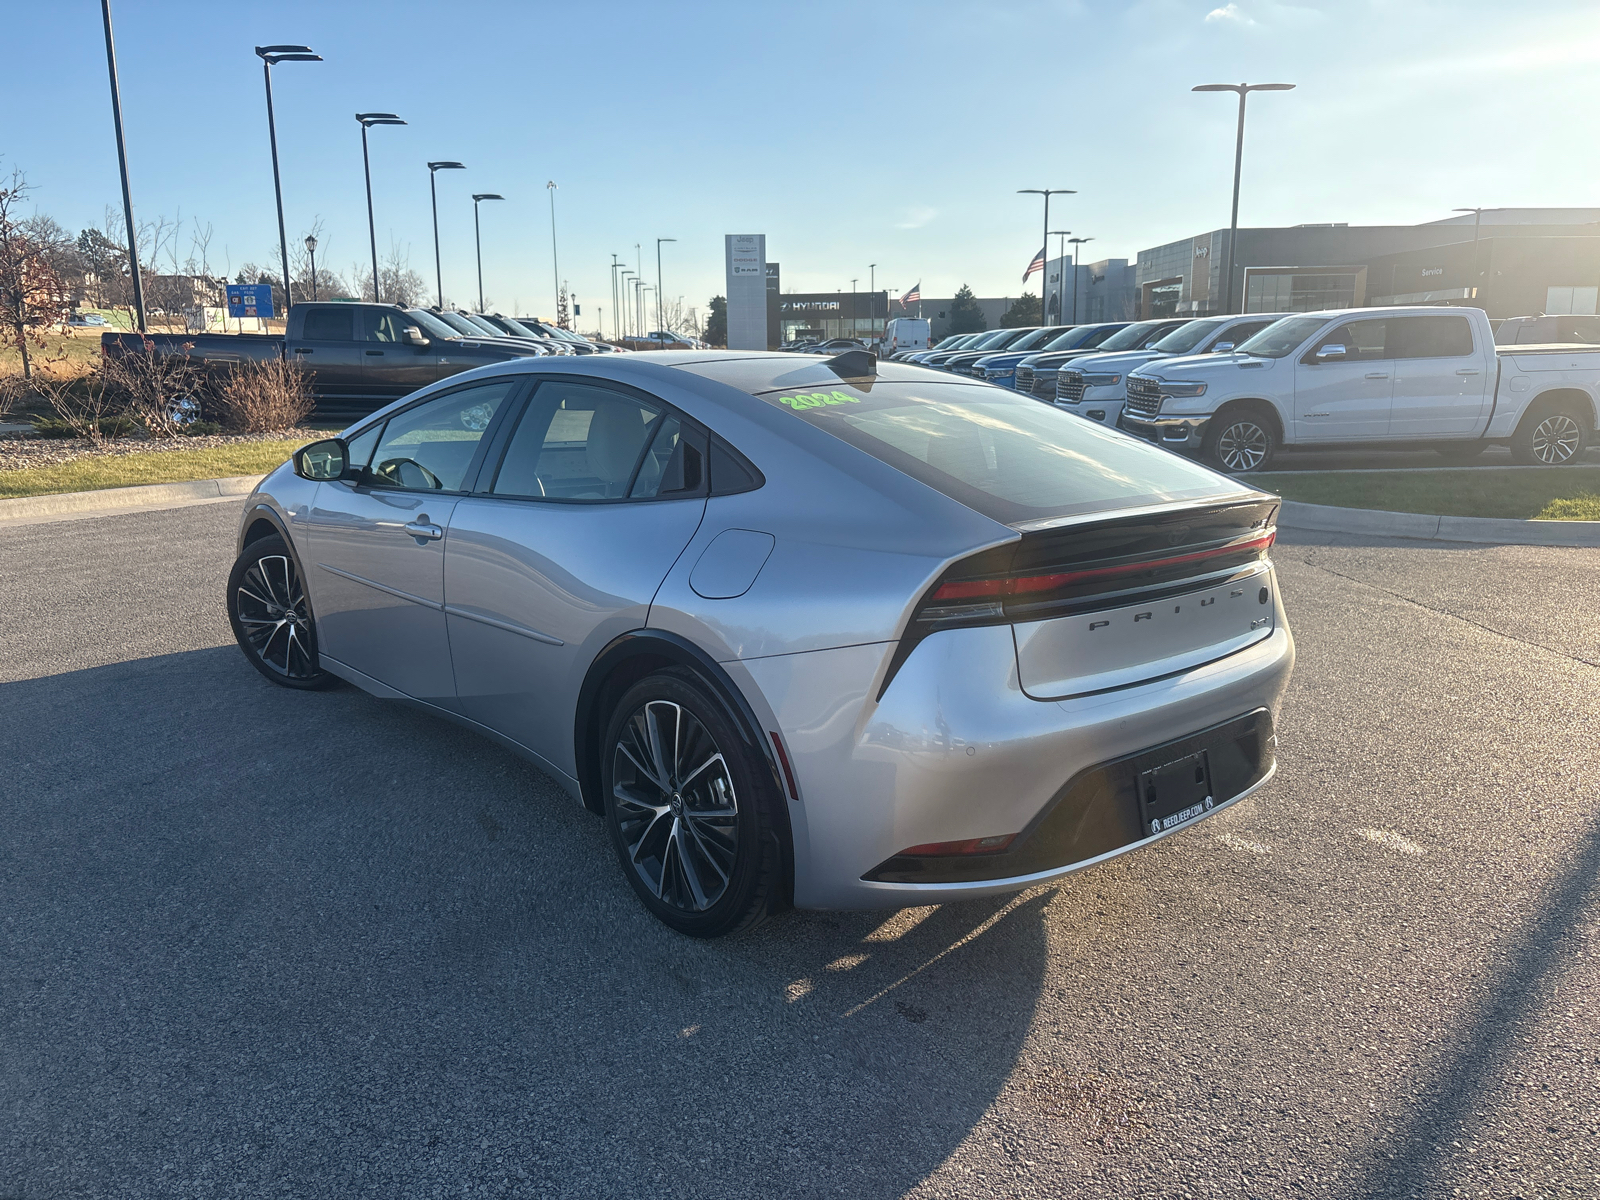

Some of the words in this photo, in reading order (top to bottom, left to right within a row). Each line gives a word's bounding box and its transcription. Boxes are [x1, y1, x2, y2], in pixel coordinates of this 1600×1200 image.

[737, 235, 753, 244] Jeep
[1421, 266, 1443, 277] Service
[792, 301, 840, 311] HYUNDAI
[778, 390, 861, 411] 2024
[1088, 588, 1244, 631] PRIUS
[1163, 804, 1203, 829] REEDJEEP.COM
